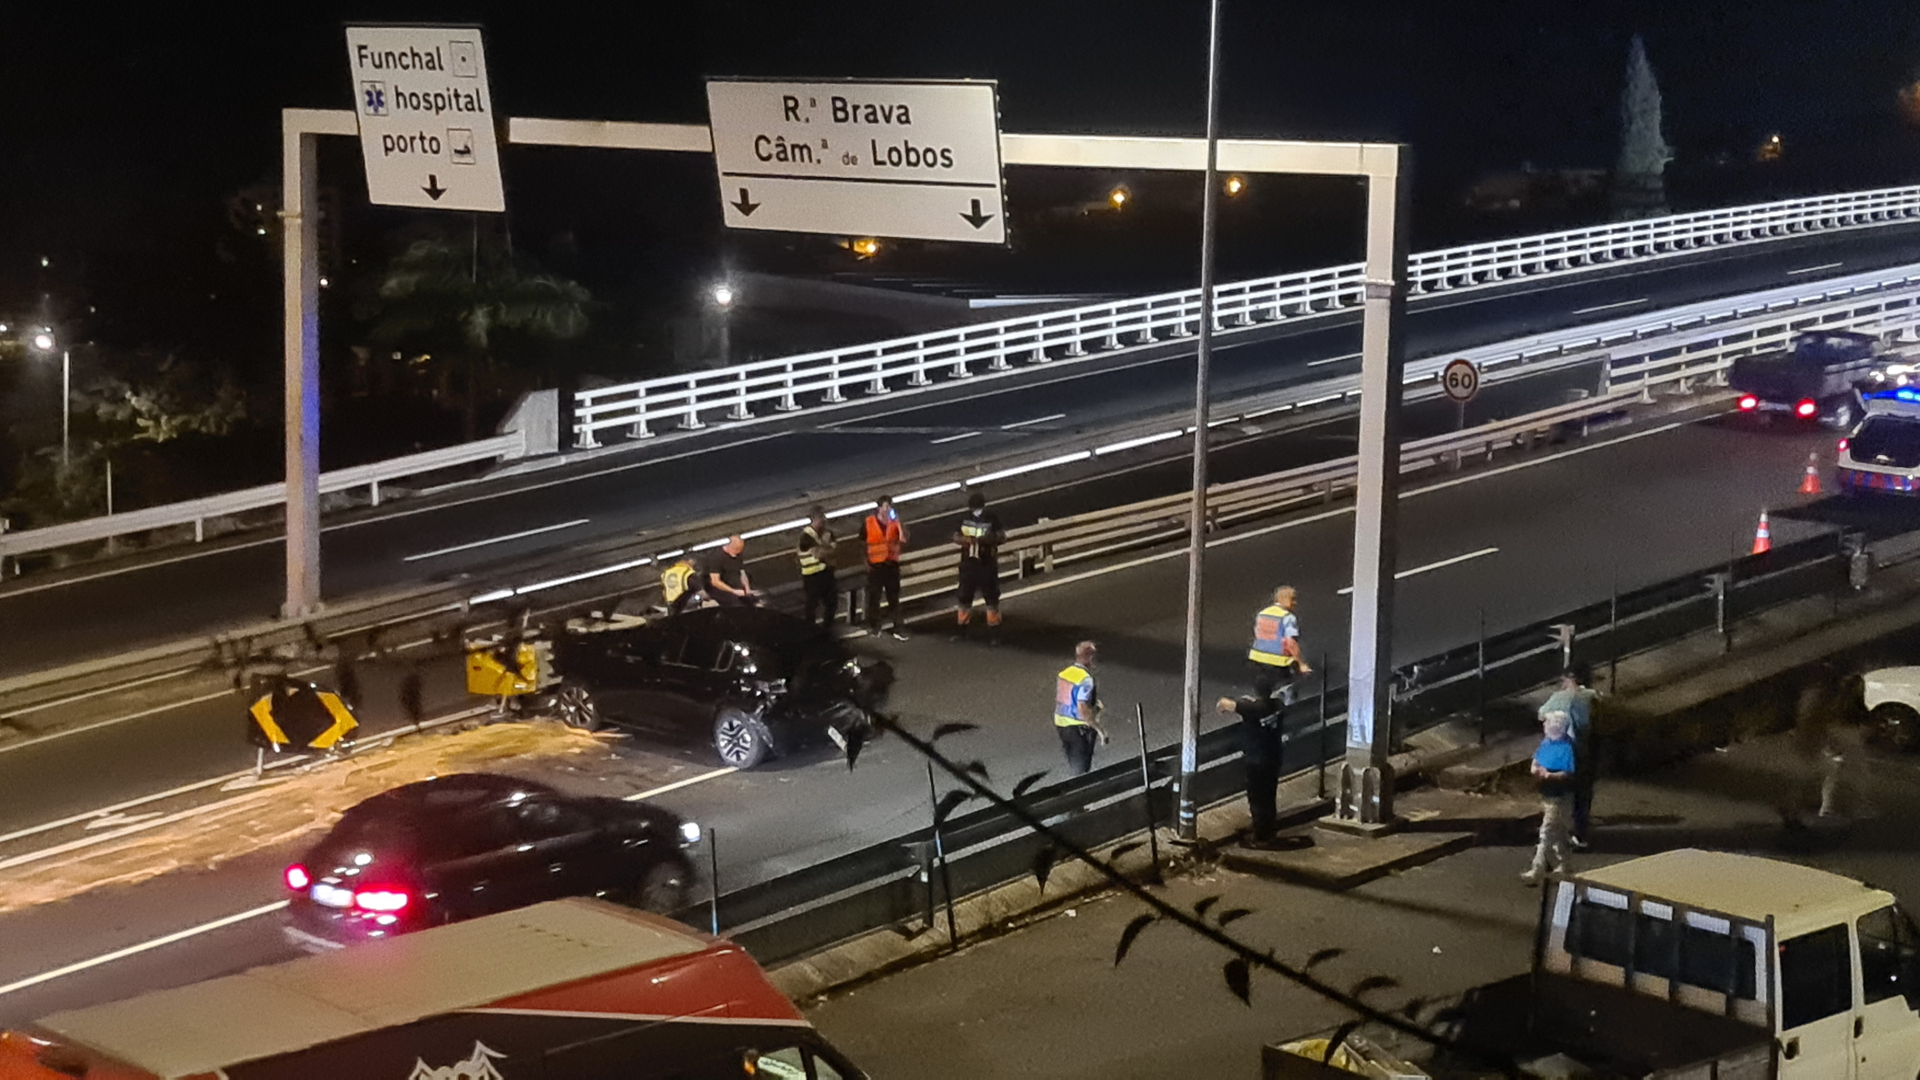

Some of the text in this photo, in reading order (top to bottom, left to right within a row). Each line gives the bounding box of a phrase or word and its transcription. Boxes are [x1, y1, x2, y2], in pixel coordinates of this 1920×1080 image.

[357, 45, 444, 71] Funchal
[394, 85, 484, 115] hospital
[831, 96, 912, 125] Brava
[382, 131, 441, 156] porto
[842, 152, 858, 166] de
[871, 139, 954, 169] Lobos
[1449, 372, 1472, 389] 60
